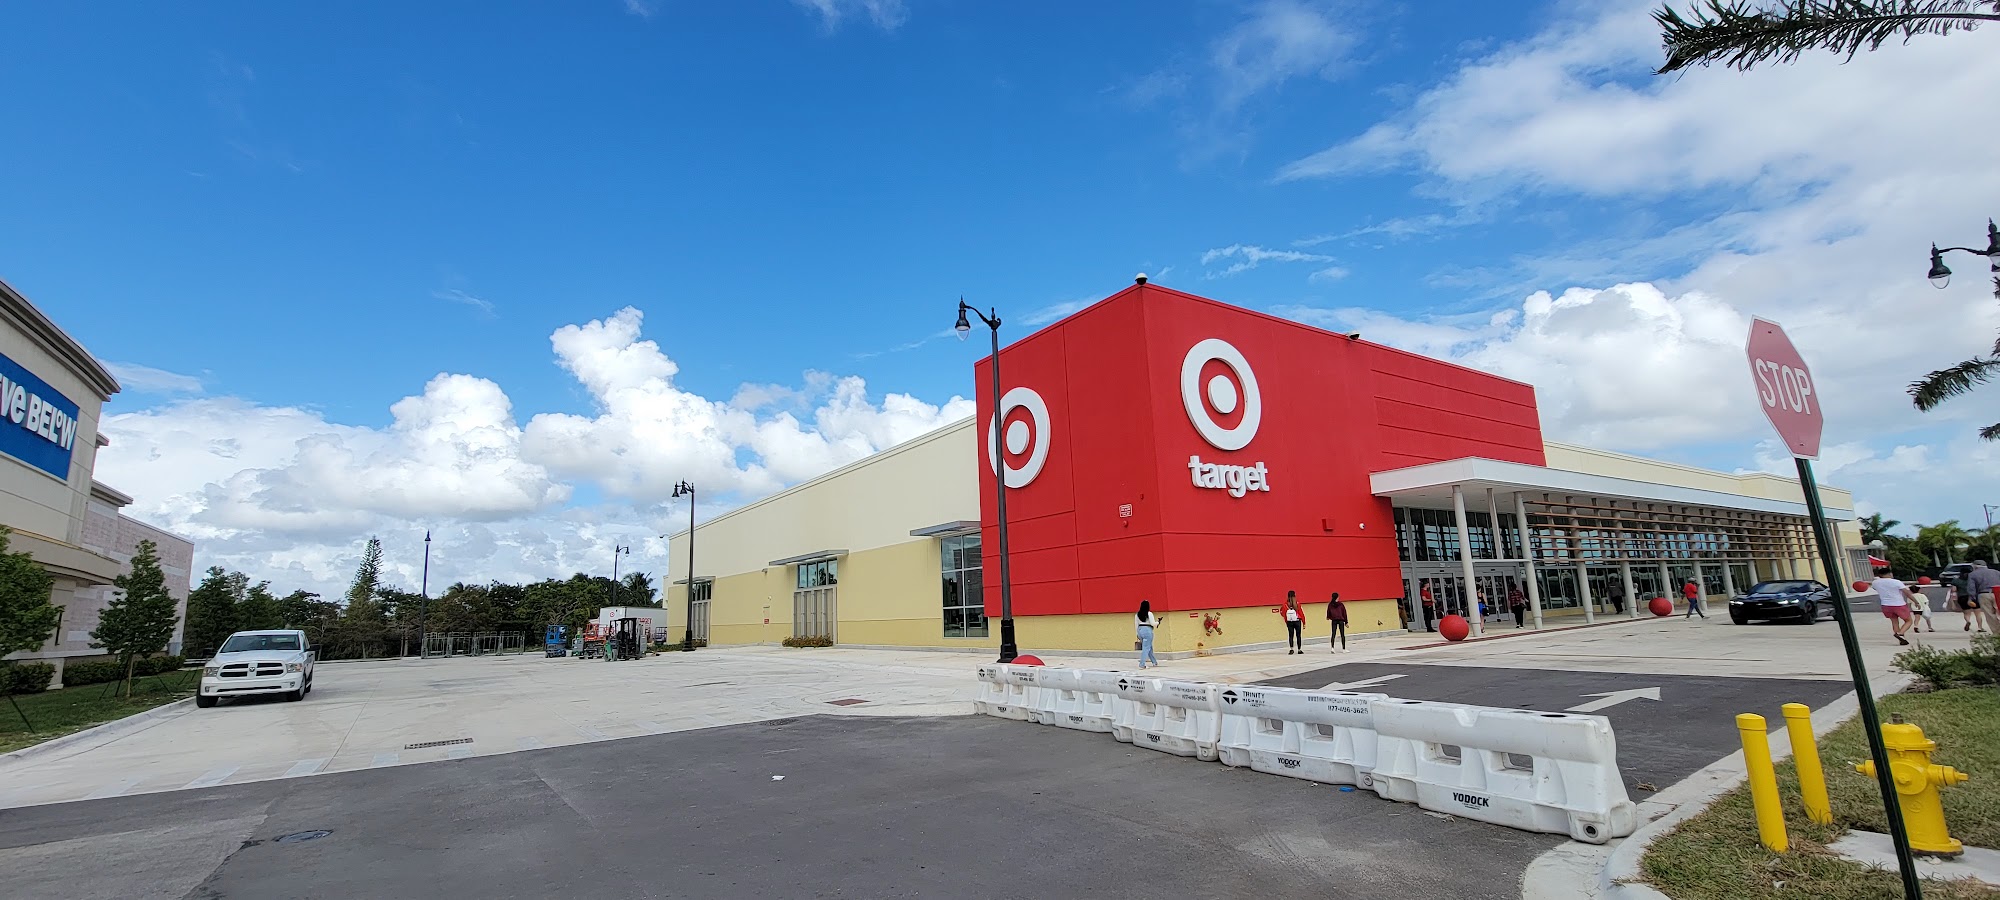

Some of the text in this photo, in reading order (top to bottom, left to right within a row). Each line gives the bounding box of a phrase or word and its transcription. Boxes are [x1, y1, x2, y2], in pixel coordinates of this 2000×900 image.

[1755, 358, 1811, 415] STOP
[0, 372, 77, 451] ve BELOW
[1188, 455, 1270, 498] target
[1242, 690, 1265, 698] TRINITY
[1277, 757, 1301, 767] YODOCK
[1453, 791, 1490, 807] YODOCK
